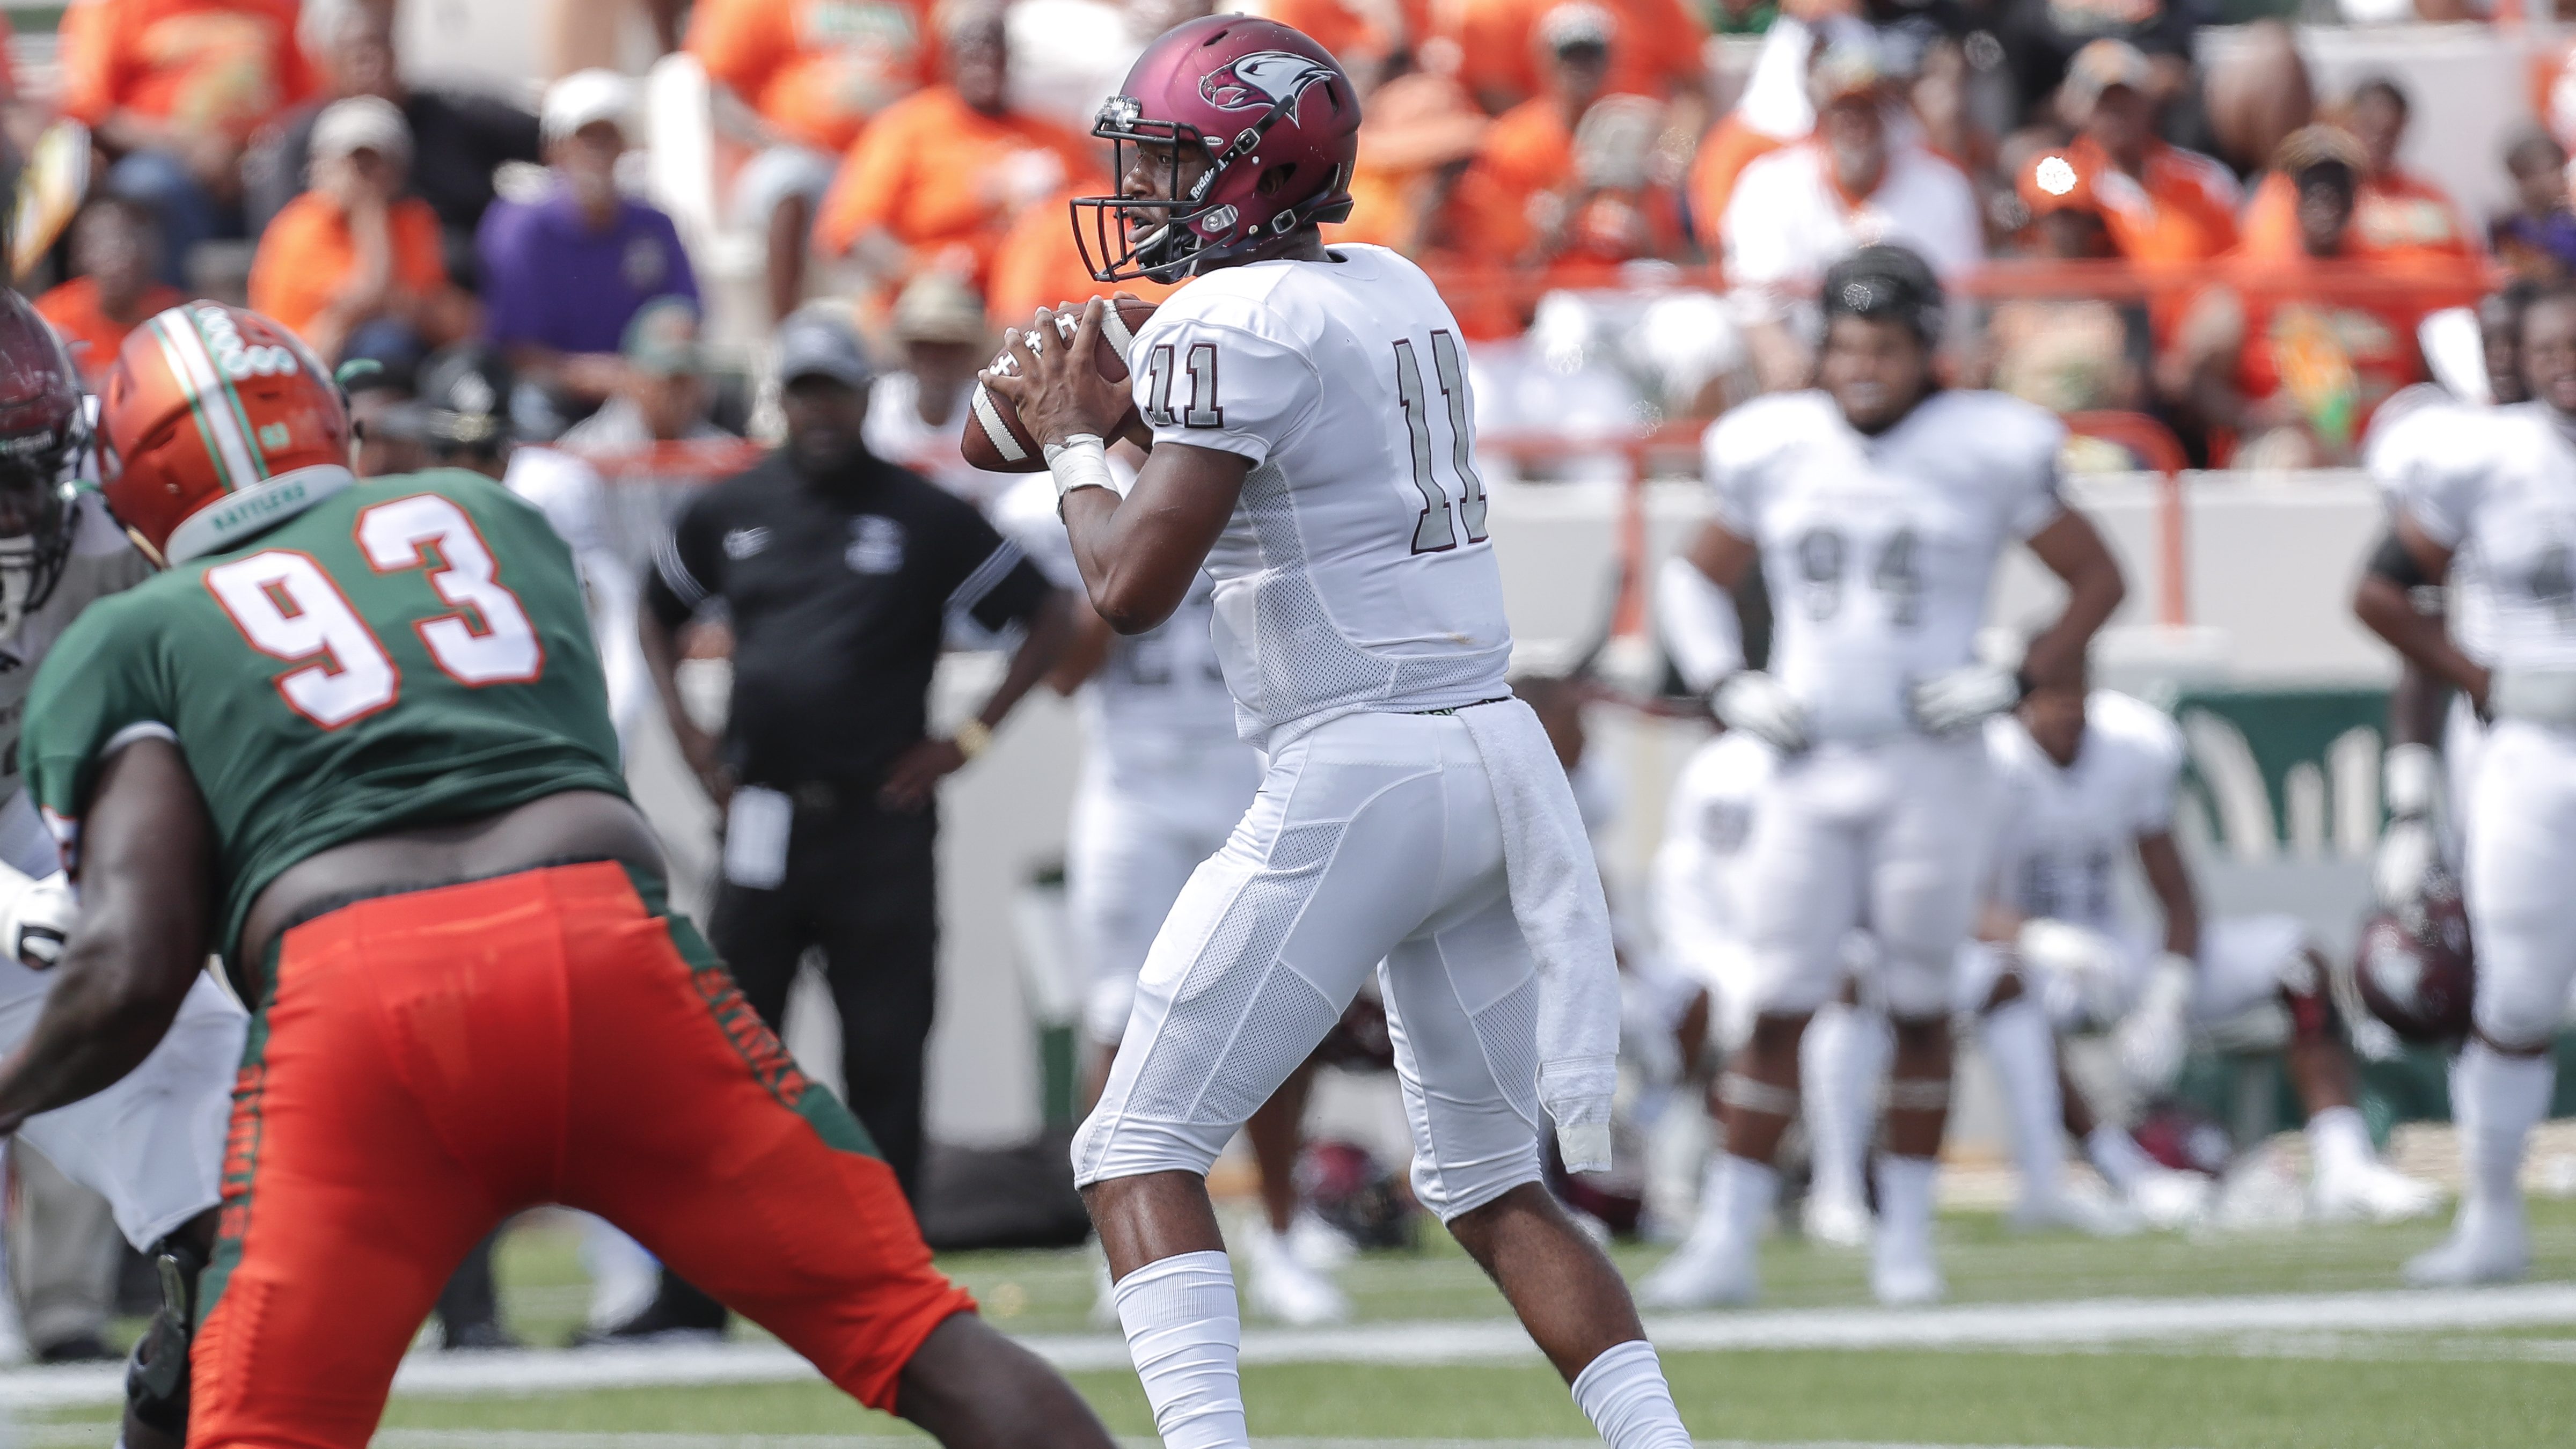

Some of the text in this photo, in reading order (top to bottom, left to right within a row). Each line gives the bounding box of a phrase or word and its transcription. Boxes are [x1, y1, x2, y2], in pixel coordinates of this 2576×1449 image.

[1145, 342, 1224, 428] 11
[1393, 328, 1488, 555] 11
[202, 492, 546, 732] 93
[1796, 524, 1923, 627] 94
